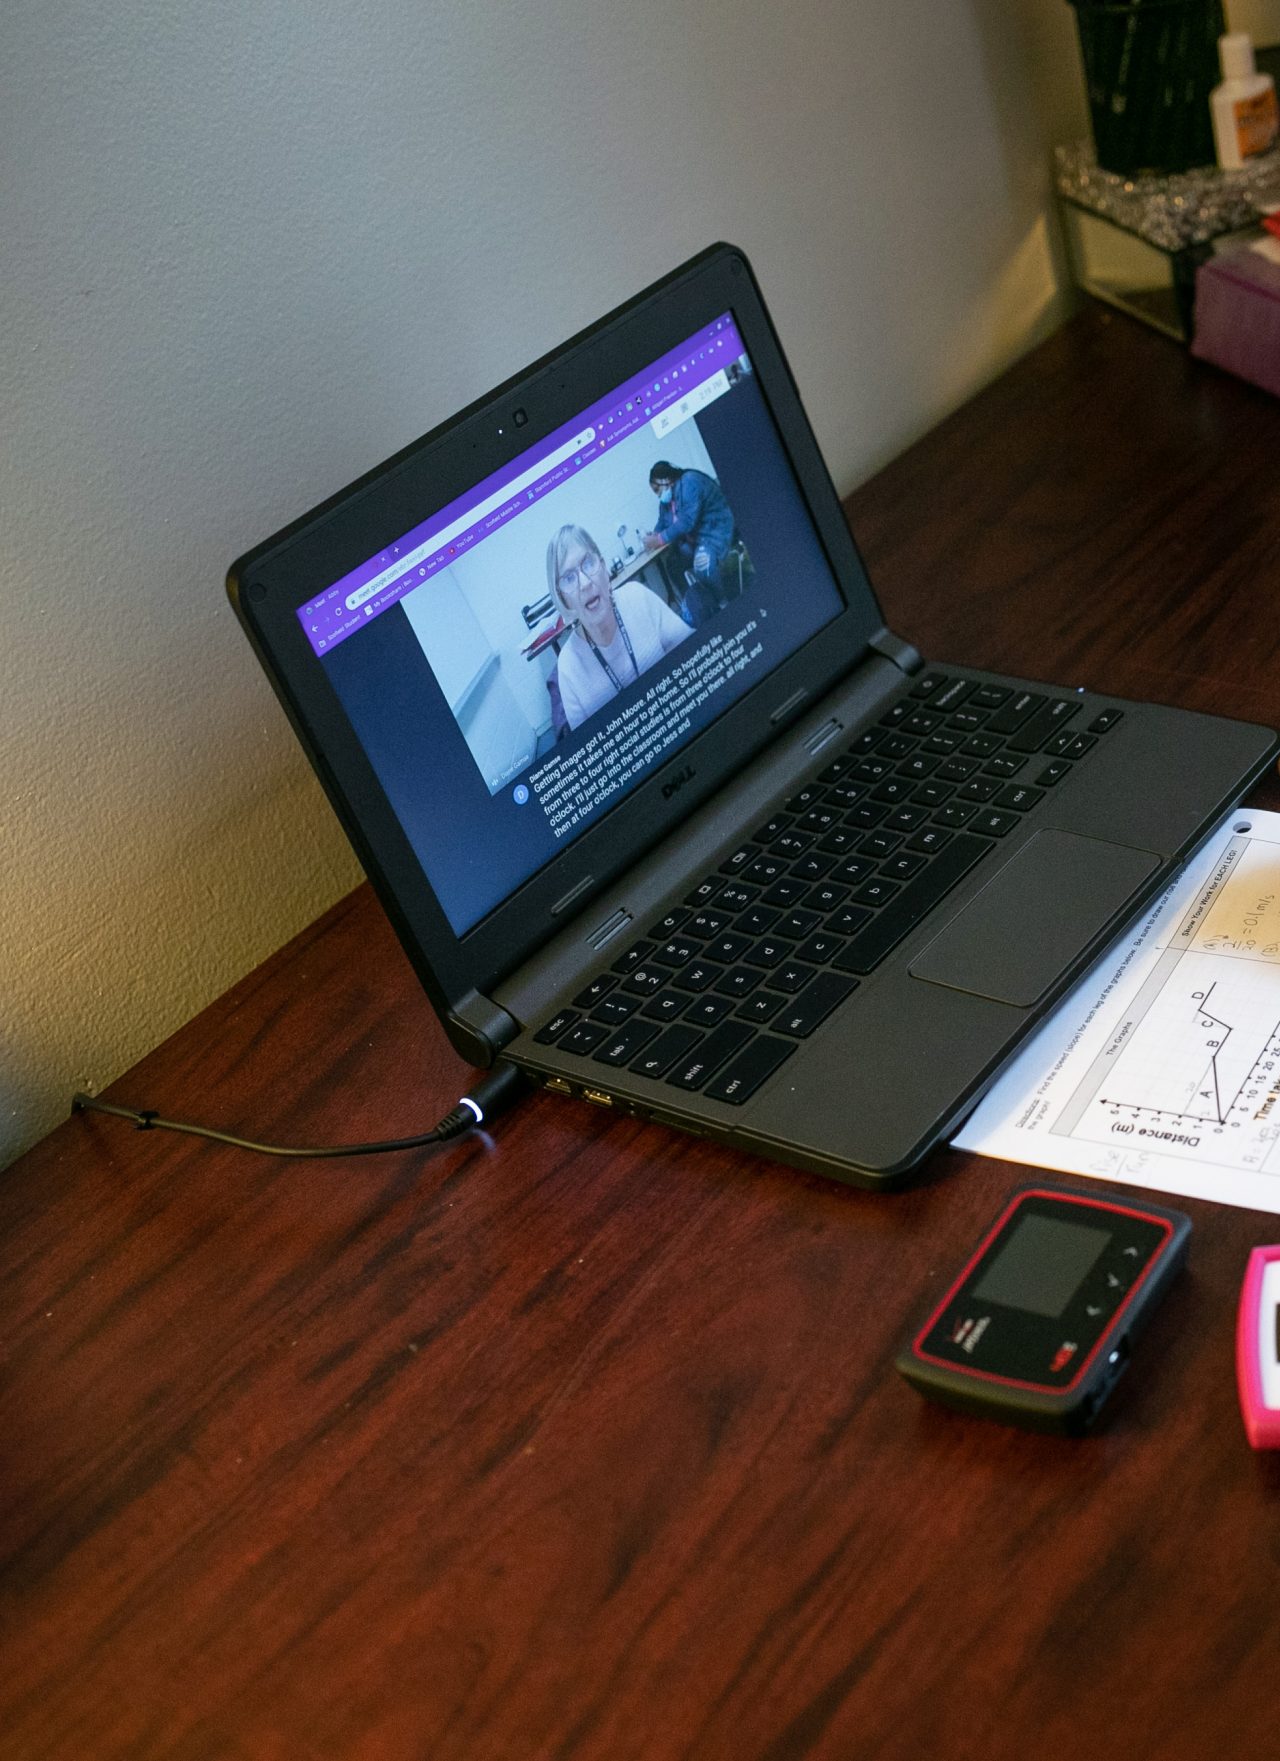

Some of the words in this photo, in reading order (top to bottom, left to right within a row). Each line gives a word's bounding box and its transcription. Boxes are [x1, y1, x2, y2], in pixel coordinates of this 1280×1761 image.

[533, 768, 561, 792] Getting
[559, 747, 586, 772] images
[585, 736, 598, 752] got
[596, 731, 606, 741] it,
[605, 716, 623, 735] John
[621, 699, 646, 720] Moore.
[646, 687, 656, 701] All
[655, 675, 673, 693] right.
[671, 667, 682, 679] So
[680, 643, 711, 671] hopefully
[709, 634, 722, 647] like
[539, 769, 578, 804] sometimes
[577, 763, 584, 772] it
[583, 748, 603, 767] takes
[602, 738, 615, 752] me
[614, 730, 624, 742] an
[622, 717, 639, 734] hour
[638, 711, 648, 721] to
[647, 700, 660, 716] get
[657, 685, 680, 705] home.
[678, 676, 689, 688] So
[688, 668, 697, 680] I'll
[696, 647, 723, 676] probably
[722, 638, 736, 654] join
[734, 628, 748, 644] you
[543, 797, 562, 815] from
[561, 782, 580, 800] three
[579, 775, 588, 785] to
[587, 762, 603, 778] four
[603, 748, 620, 766] right
[619, 730, 640, 753] social
[639, 712, 664, 736] studies
[662, 706, 670, 716] is
[669, 693, 686, 710] from
[685, 679, 703, 697] three
[702, 661, 725, 683] o'clock
[723, 655, 732, 665] to
[730, 644, 744, 659] four
[549, 802, 576, 826] o'clock.
[574, 792, 585, 805] I'll
[583, 781, 598, 800] just
[597, 774, 608, 788] go
[606, 763, 621, 778] into
[620, 753, 633, 766] the
[632, 724, 667, 757] classroom
[666, 711, 680, 728] and
[679, 698, 696, 718] meet
[695, 689, 709, 705] you
[707, 675, 726, 693] there.
[726, 666, 735, 678] all
[749, 642, 762, 658] and
[529, 769, 544, 783] Diane
[543, 755, 561, 771] Gamse
[554, 820, 571, 837] then
[571, 812, 579, 824] at
[578, 800, 593, 817] four
[593, 780, 619, 804] o'clock,
[618, 769, 632, 786] you
[631, 758, 645, 772] can
[644, 750, 654, 763] go
[653, 743, 662, 754] to
[662, 730, 678, 747] Jess
[677, 717, 691, 734] and
[517, 790, 524, 799] D
[1013, 790, 1026, 801] ctrl
[1181, 919, 1195, 936] Show
[1191, 905, 1203, 918] Your
[1199, 890, 1213, 905] Work
[1208, 881, 1218, 890] for
[1214, 864, 1229, 881] EACH
[1036, 1081, 1050, 1094] Find
[1046, 1071, 1056, 1080] the
[1054, 1051, 1069, 1070] speed
[1065, 1032, 1083, 1052] (slope)
[1077, 1023, 1086, 1031] for
[1084, 1009, 1096, 1023] each
[1092, 1000, 1104, 1009] leg
[1099, 992, 1107, 1000] of
[1103, 984, 1113, 993] the
[1110, 965, 1126, 984] graphs
[1132, 937, 1143, 946] Be
[1140, 925, 1151, 937] sure
[1151, 904, 1163, 918] draw
[1160, 895, 1169, 904] our
[1191, 991, 1204, 999] D
[549, 1018, 564, 1030] esc
[790, 1018, 802, 1028] alt
[1201, 1019, 1214, 1027] C
[1105, 1044, 1118, 1055] The
[1113, 1021, 1132, 1043] Graphs
[1206, 1039, 1219, 1047] B
[609, 1044, 624, 1056] tab
[684, 1064, 703, 1080] shift
[1262, 1060, 1274, 1071] 20
[1254, 1075, 1266, 1083] 15
[726, 1079, 741, 1093] ctrl
[1199, 1090, 1212, 1098] A
[1246, 1089, 1258, 1098] 10
[1253, 1096, 1276, 1120] Time
[1111, 1121, 1134, 1133] (m)
[1138, 1128, 1200, 1146] Distance
